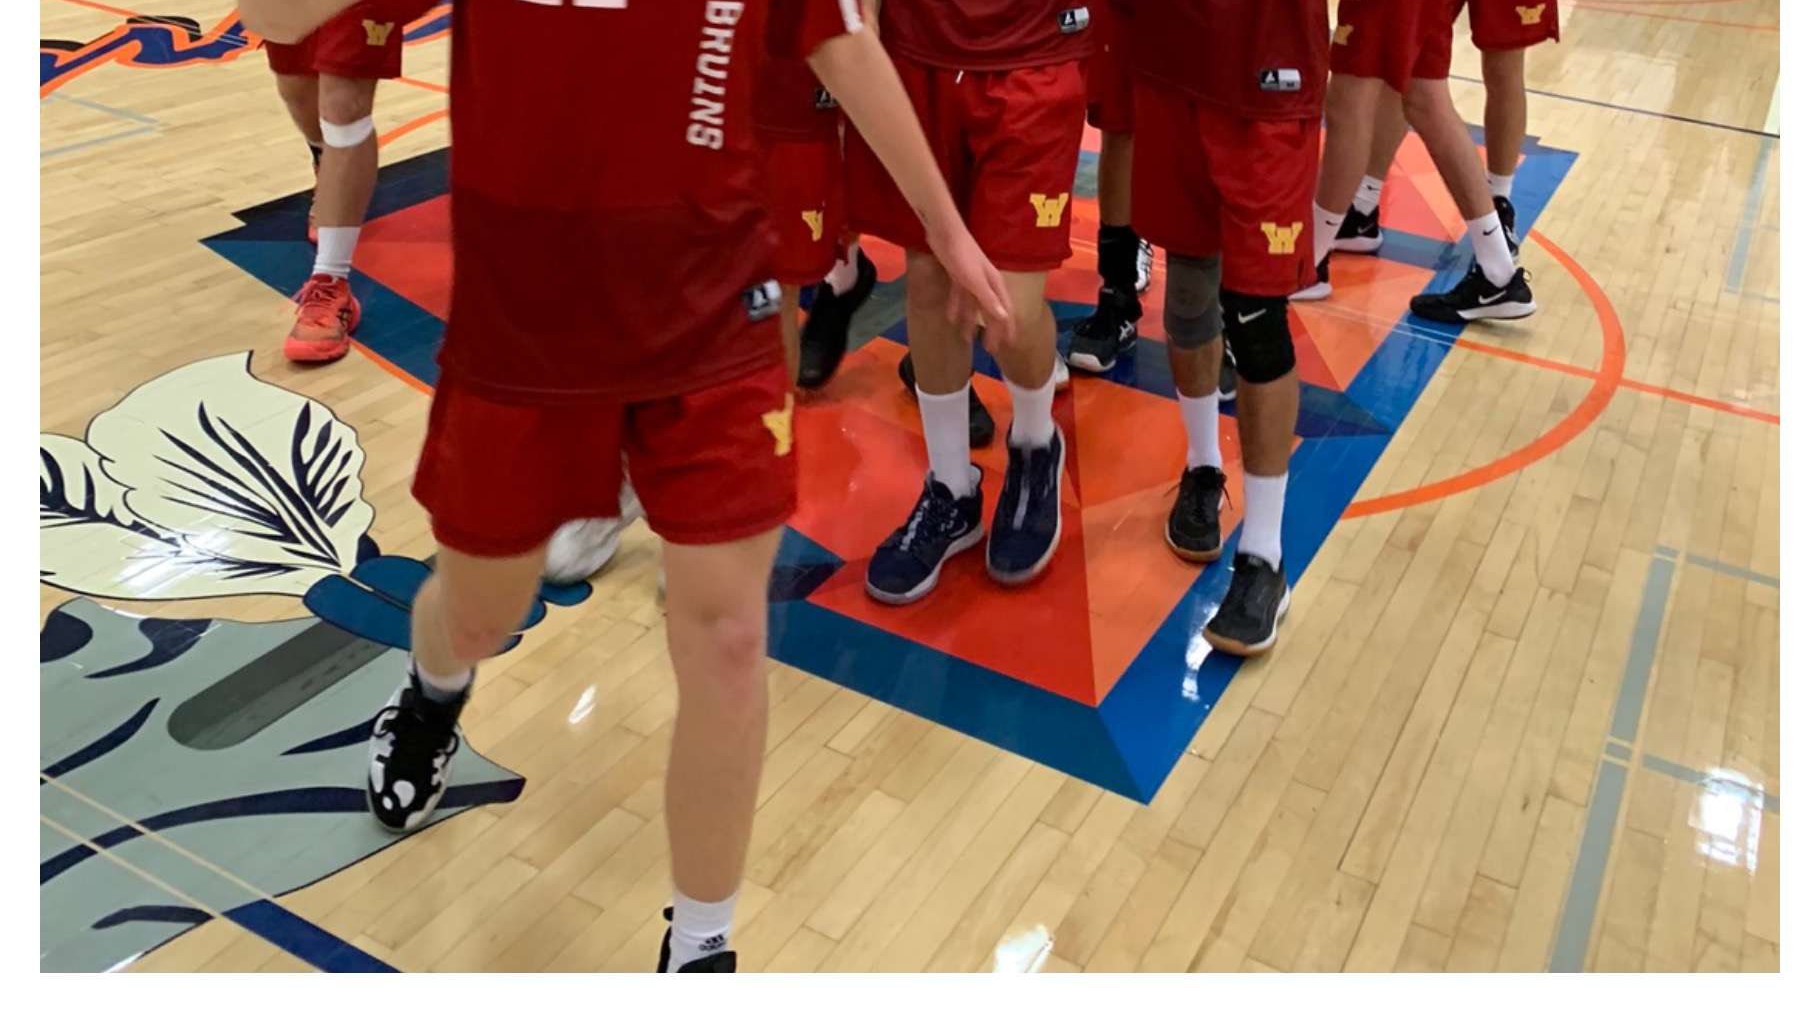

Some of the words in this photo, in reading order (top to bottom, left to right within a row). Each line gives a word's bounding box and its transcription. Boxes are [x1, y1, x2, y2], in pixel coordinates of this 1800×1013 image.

[362, 19, 395, 45] W
[685, 0, 746, 150] BRUINS
[1029, 192, 1069, 227] W
[1260, 222, 1304, 254] W
